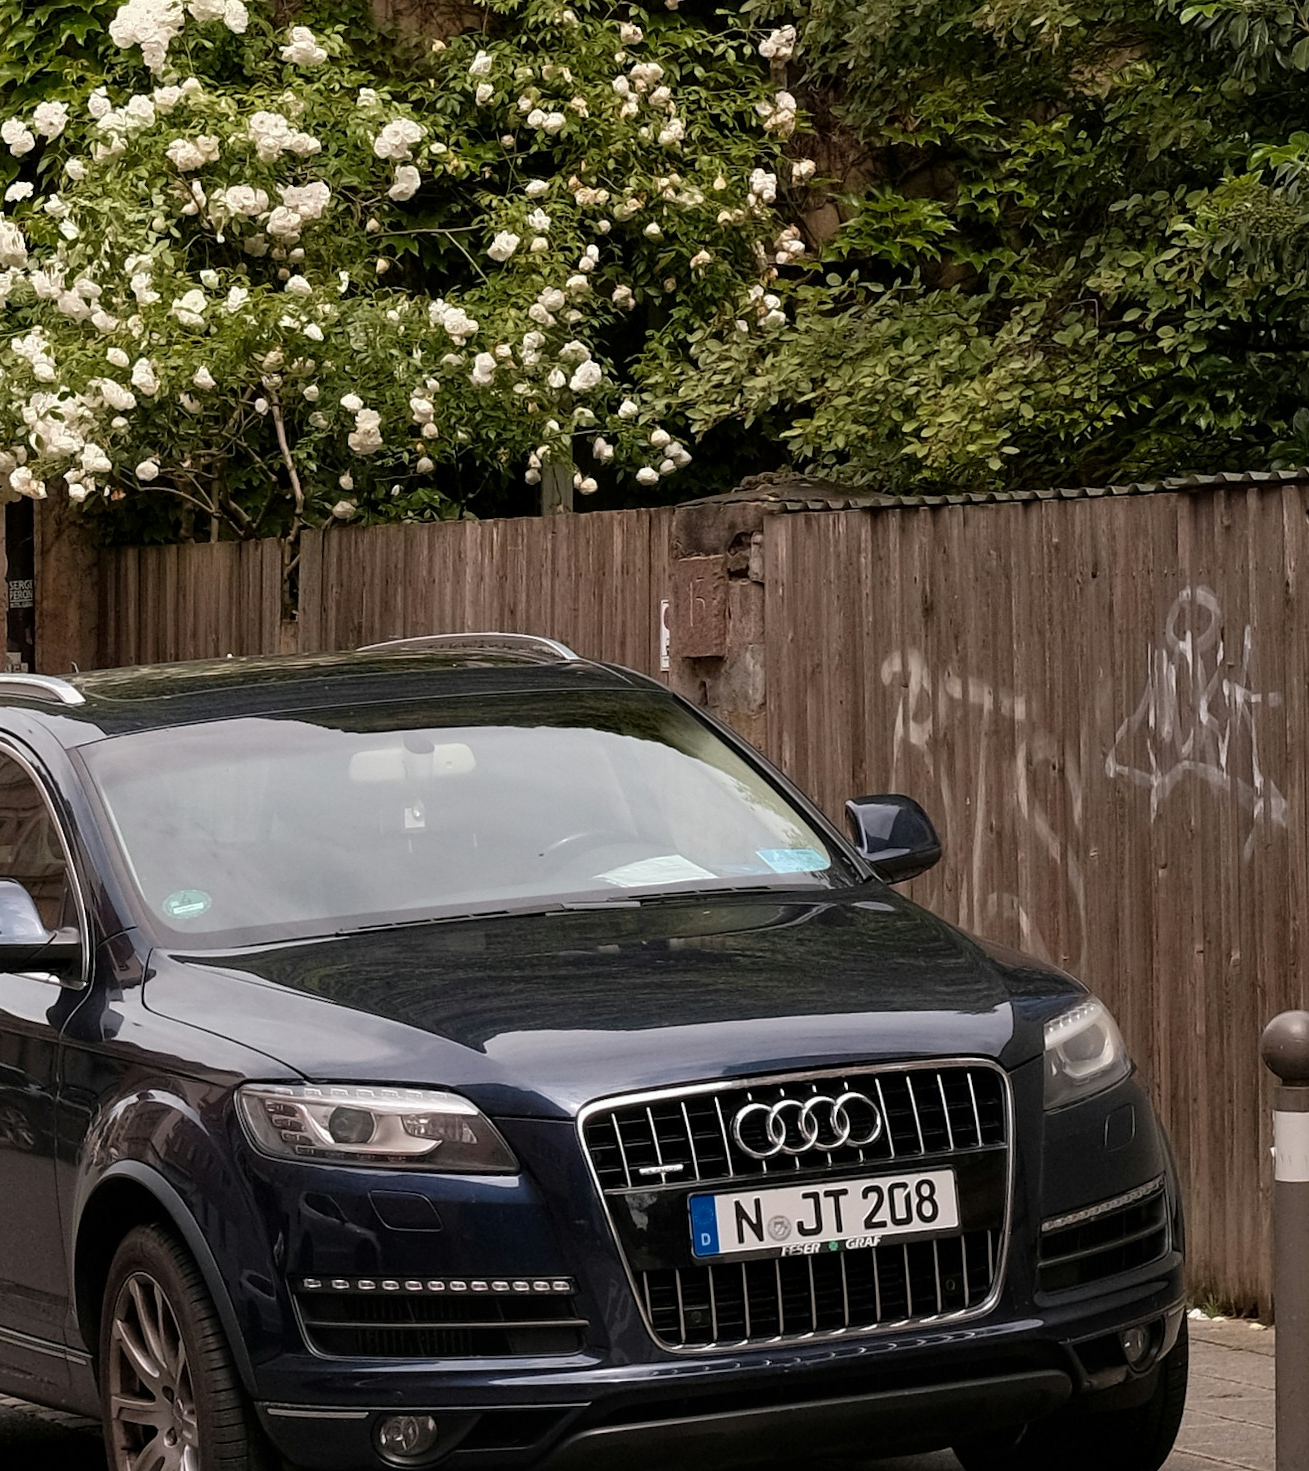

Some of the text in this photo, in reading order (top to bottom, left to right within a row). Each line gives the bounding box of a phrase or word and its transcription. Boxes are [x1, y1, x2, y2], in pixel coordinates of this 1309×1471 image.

[734, 1179, 940, 1244] N JT 208
[700, 1232, 712, 1247] D
[781, 1236, 882, 1257] FESER GRAF
